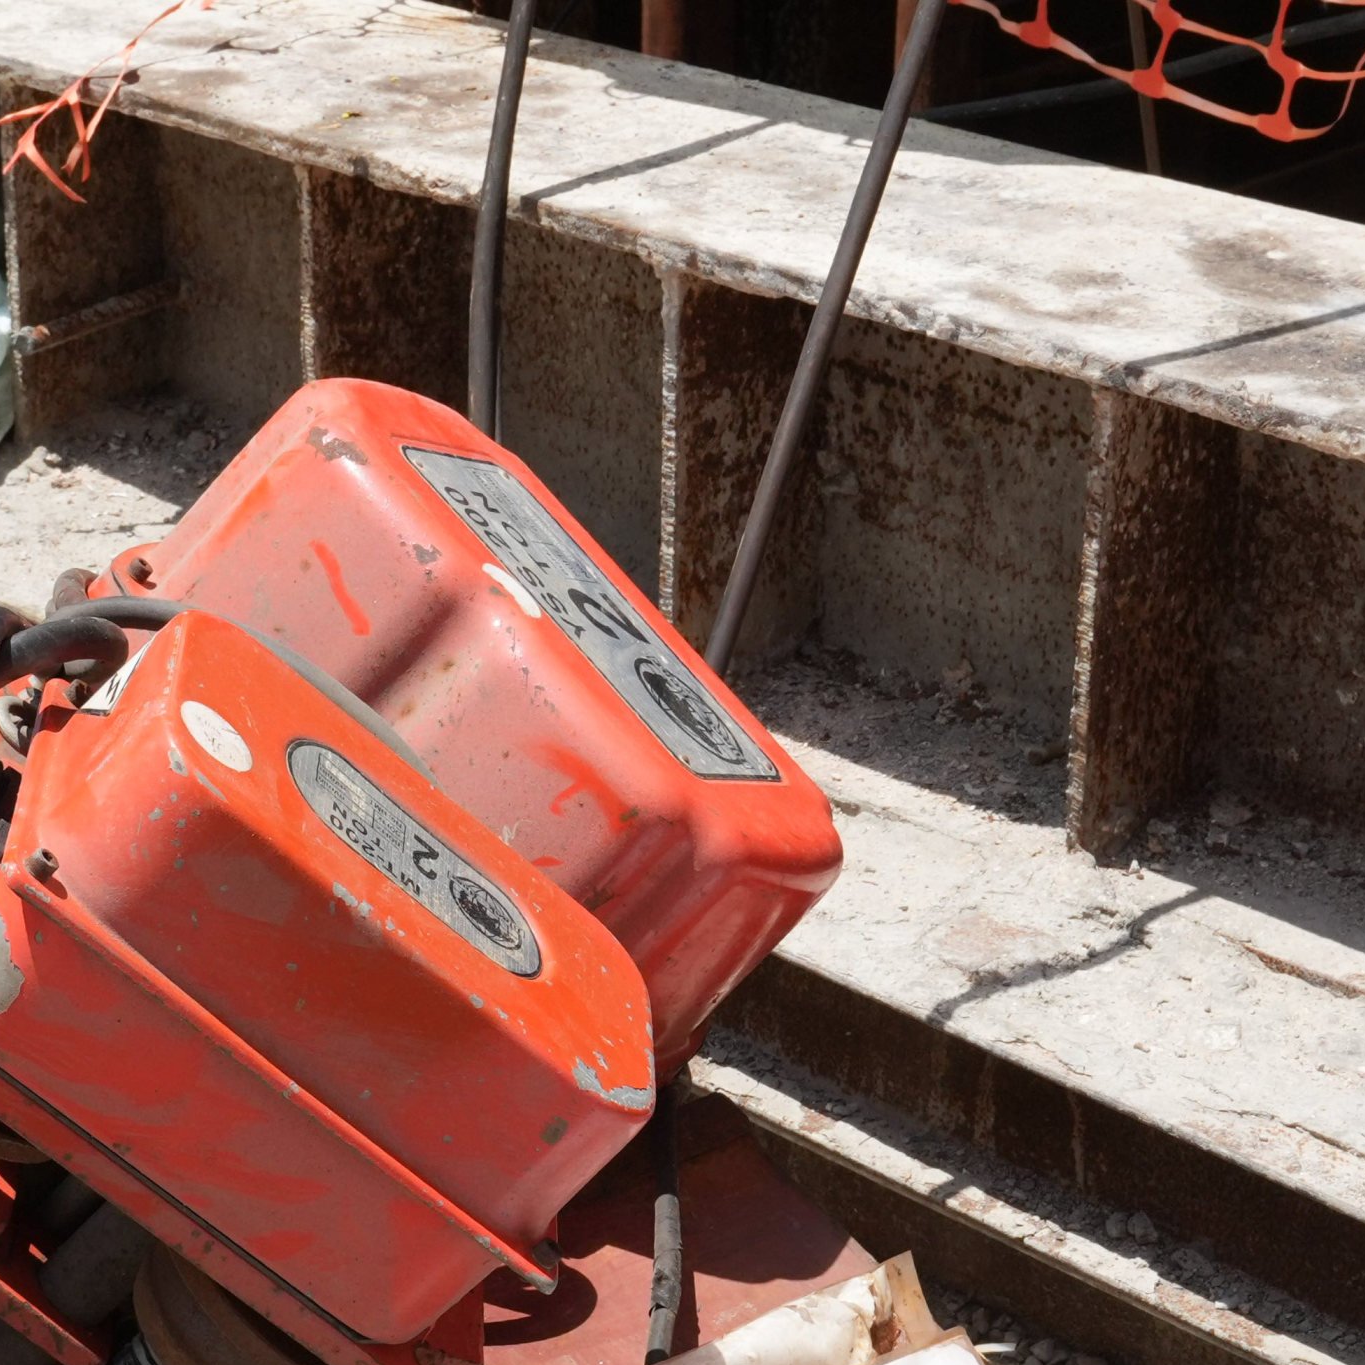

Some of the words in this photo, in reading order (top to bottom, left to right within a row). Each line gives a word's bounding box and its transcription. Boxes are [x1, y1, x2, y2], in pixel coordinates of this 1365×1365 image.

[444, 486, 586, 639] YSS-200
[471, 490, 551, 575] TON
[567, 587, 650, 644] 2
[329, 814, 421, 897] MT-200
[332, 801, 385, 852] TON
[412, 833, 440, 881] 2
